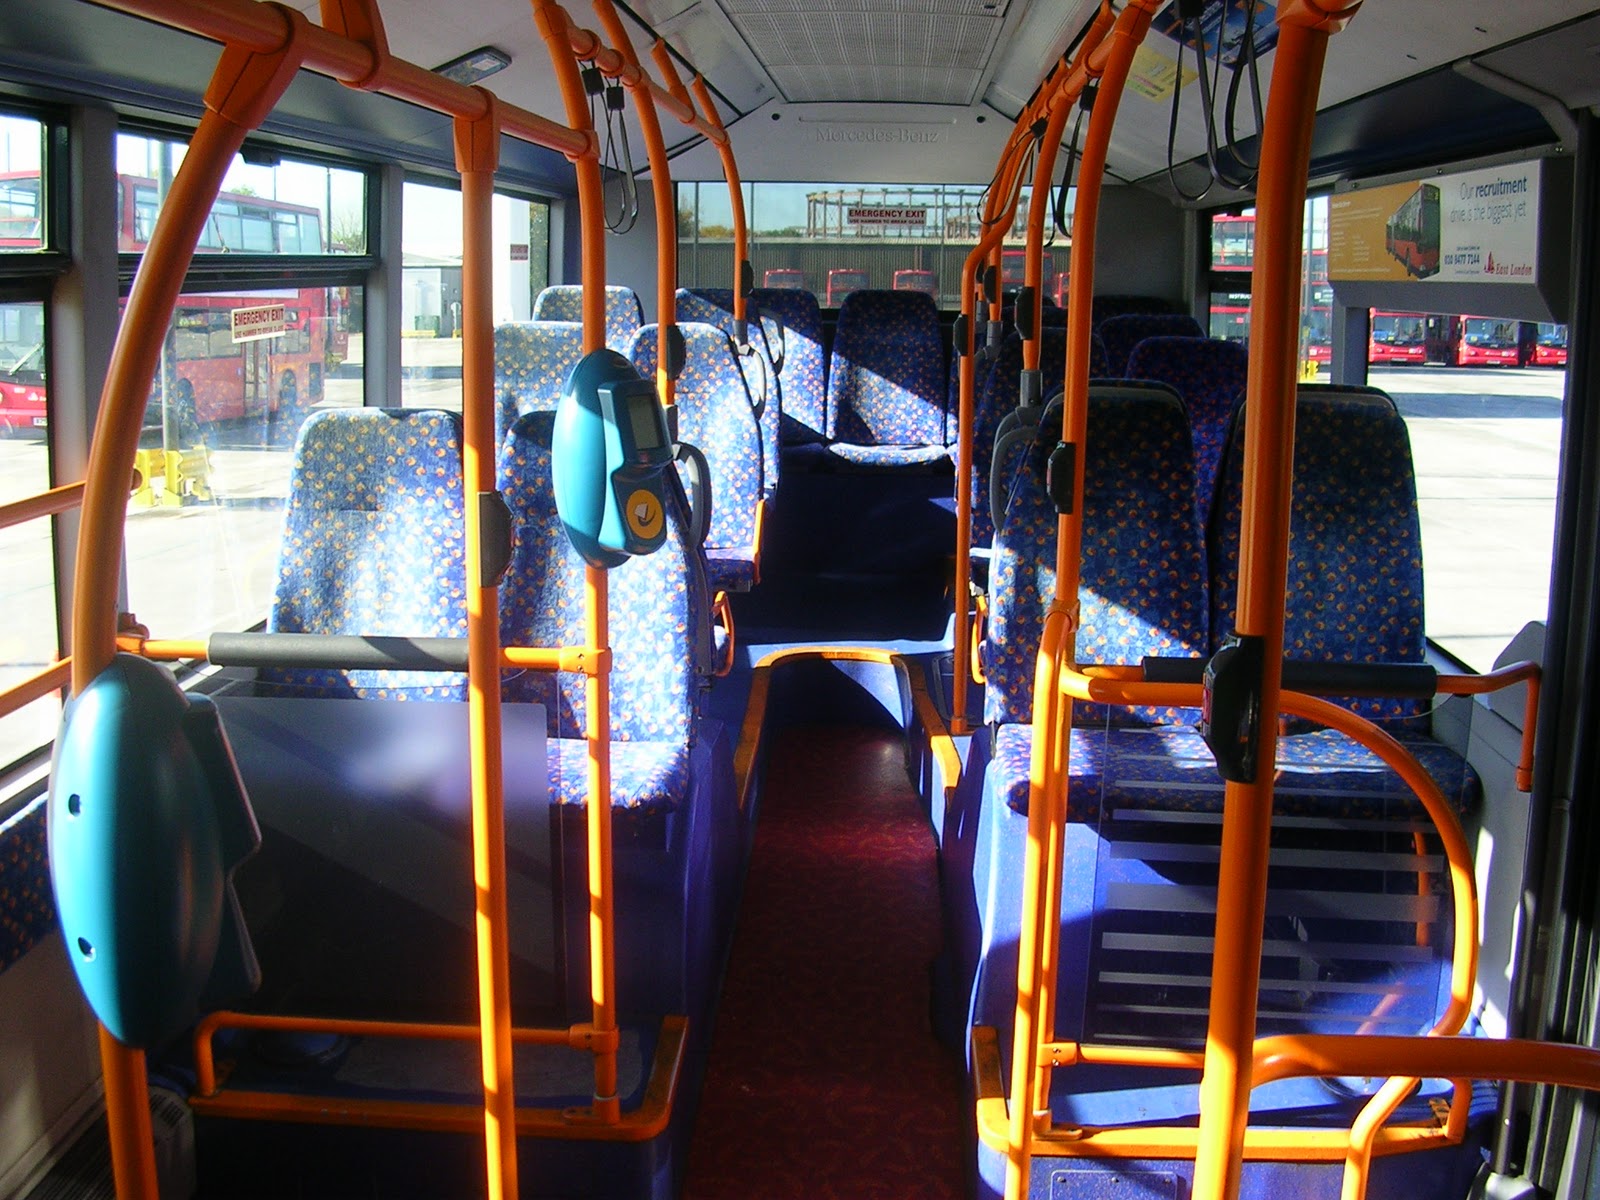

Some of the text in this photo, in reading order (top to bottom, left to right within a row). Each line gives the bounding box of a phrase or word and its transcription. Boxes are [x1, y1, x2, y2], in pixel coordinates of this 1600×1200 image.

[816, 127, 939, 143] Mercedes-Benz
[1460, 177, 1527, 200] Our recruitment
[849, 209, 925, 218] EMERGENCY EXIT
[1486, 202, 1512, 225] biggest
[1514, 202, 1526, 222] yet
[1495, 263, 1532, 276] East London
[234, 308, 284, 326] EMERGENCY EXIT
[234, 331, 242, 339] USE
[243, 328, 257, 337] HAMMER
[258, 327, 262, 335] TO
